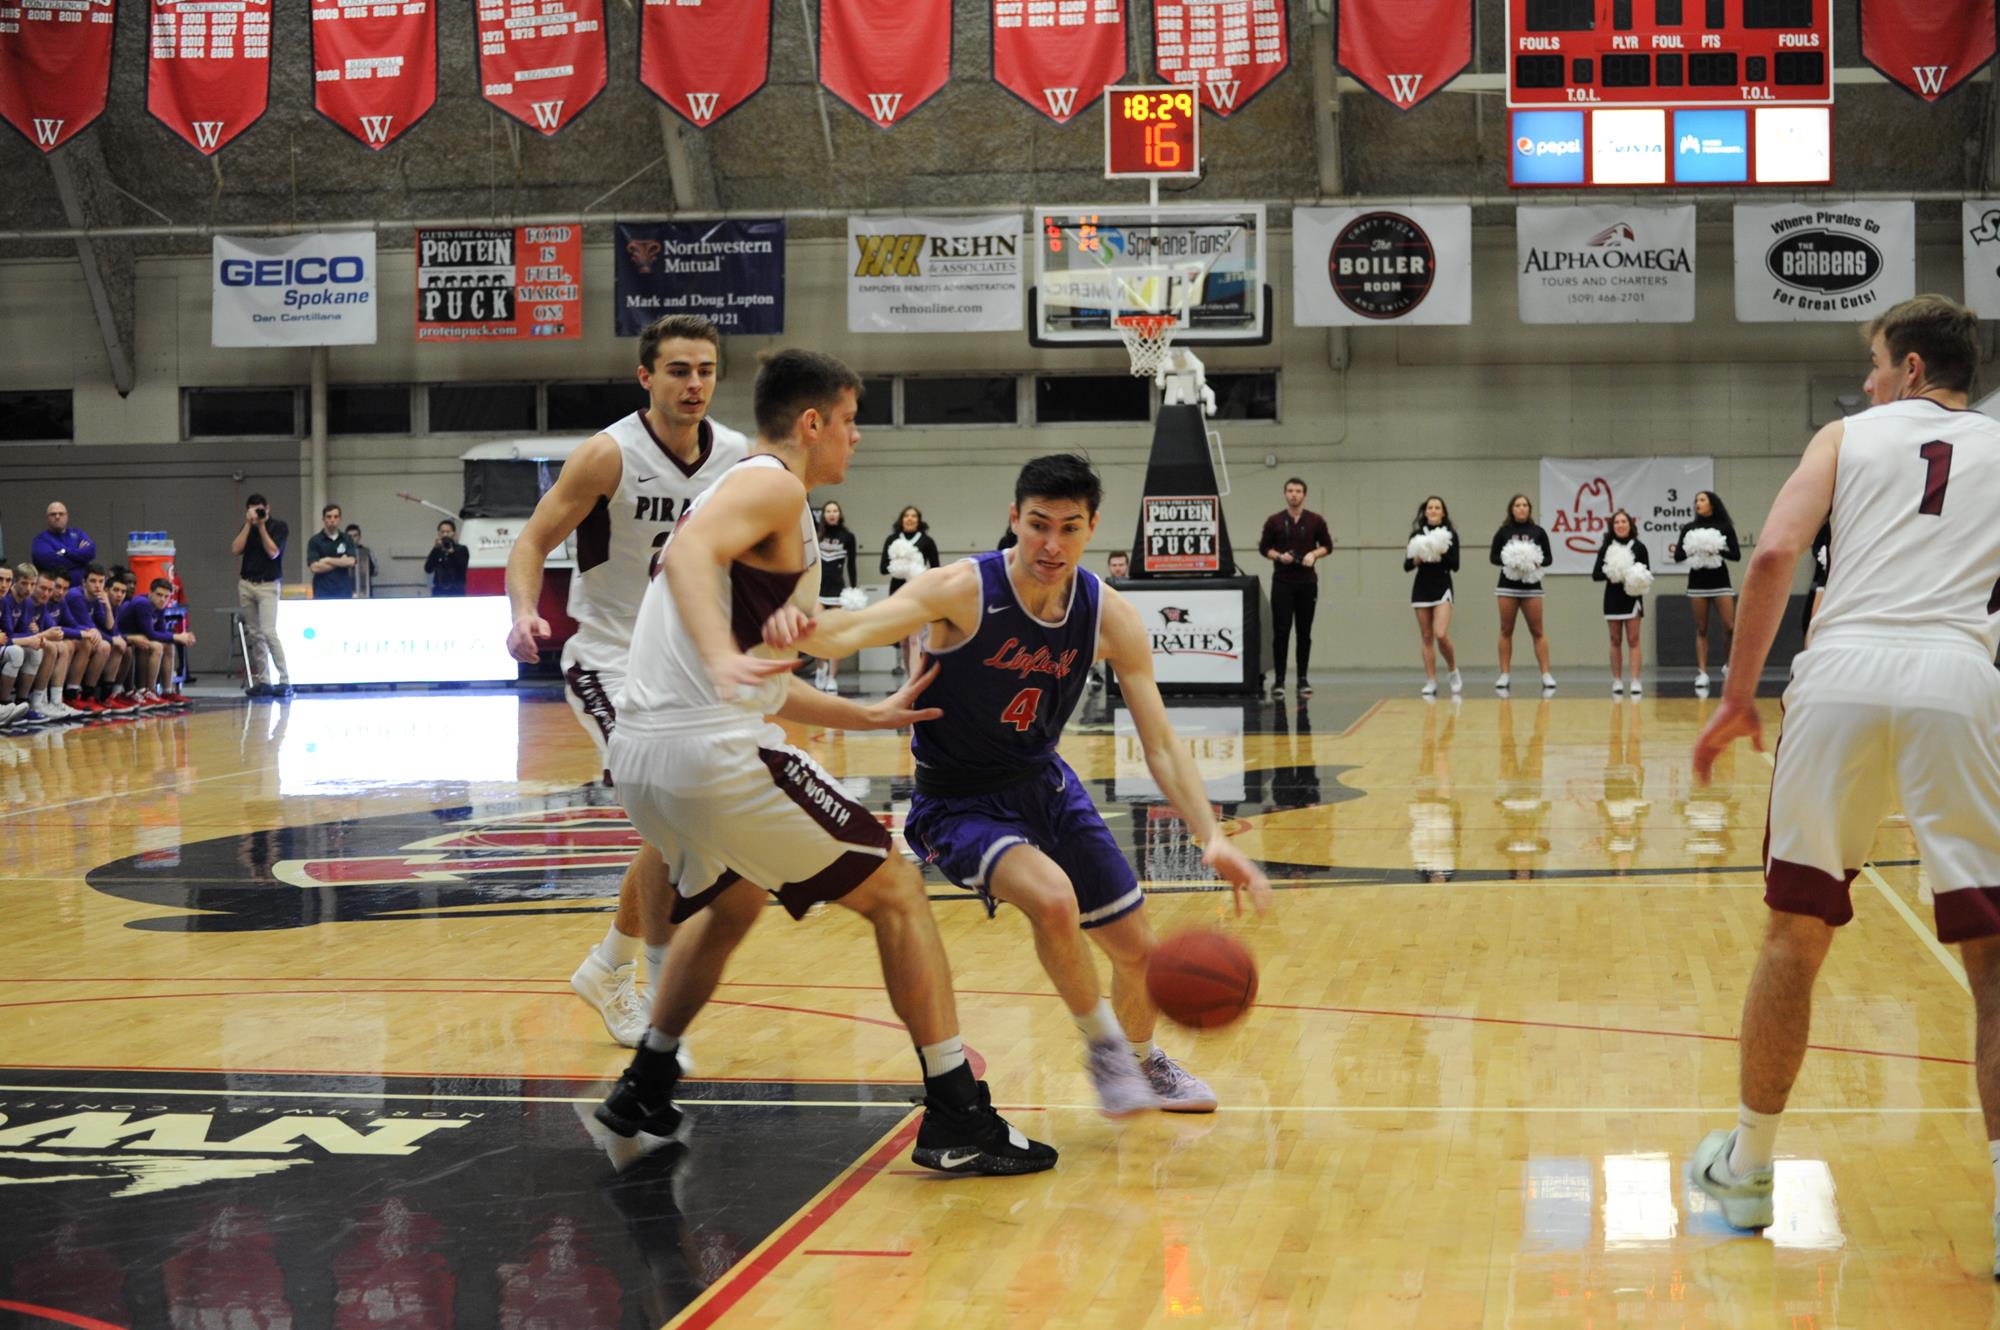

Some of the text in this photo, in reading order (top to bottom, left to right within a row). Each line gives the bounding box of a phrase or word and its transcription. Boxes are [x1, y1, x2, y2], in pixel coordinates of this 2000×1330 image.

[1520, 37, 1560, 50] FOULS
[1613, 35, 1721, 49] PLYR FOUL PTS
[1779, 34, 1819, 47] FOULS
[1387, 75, 1423, 103] W
[1912, 66, 1948, 94] W
[1043, 88, 1078, 116] W
[1205, 80, 1241, 109] W
[1566, 88, 1601, 102] T.O.L.
[1741, 86, 1775, 100] T.O.L.
[532, 101, 564, 128] W
[686, 93, 719, 120] W
[868, 94, 902, 121] W
[1124, 93, 1192, 121] 18:29
[34, 119, 64, 146] W
[193, 121, 225, 148] W
[361, 116, 394, 143] W
[1145, 122, 1180, 167] 16
[1536, 138, 1581, 156] pepsi
[1771, 211, 1881, 234] Where Pirates Go
[526, 227, 571, 243] FOOD
[421, 238, 512, 267] PROTEIN
[540, 246, 556, 262] IS
[664, 239, 773, 255] Northwestern
[930, 234, 1018, 257] REHN
[1798, 242, 1814, 250] THE
[664, 256, 721, 273] Mutual
[941, 262, 1016, 273] ASSOCIATES
[1339, 256, 1425, 275] BOILER
[1523, 247, 1693, 274] ALPHA OMEGA
[220, 256, 364, 287] GEICO
[859, 285, 901, 293] EMPLOYEE
[904, 284, 941, 292] BENEFITS
[1364, 282, 1402, 292] ROOM
[1541, 276, 1668, 287] TOURS AND CHARTERS
[284, 289, 369, 310] Spokane
[518, 285, 578, 301] MARCH
[626, 293, 774, 308] Mark and Doug Lupton
[1773, 288, 1877, 311] For Great Cuts!
[425, 289, 508, 320] PUCK
[889, 303, 983, 314] rehnonline.com
[252, 314, 276, 323] Dan
[419, 325, 517, 339] proteinpuck.com
[1918, 439, 1953, 517] 1
[1667, 489, 1678, 502] 3
[1149, 505, 1213, 522] PROTEIN
[1654, 506, 1692, 518] Point
[1152, 535, 1211, 556] PUCK
[1001, 687, 1043, 732] 4
